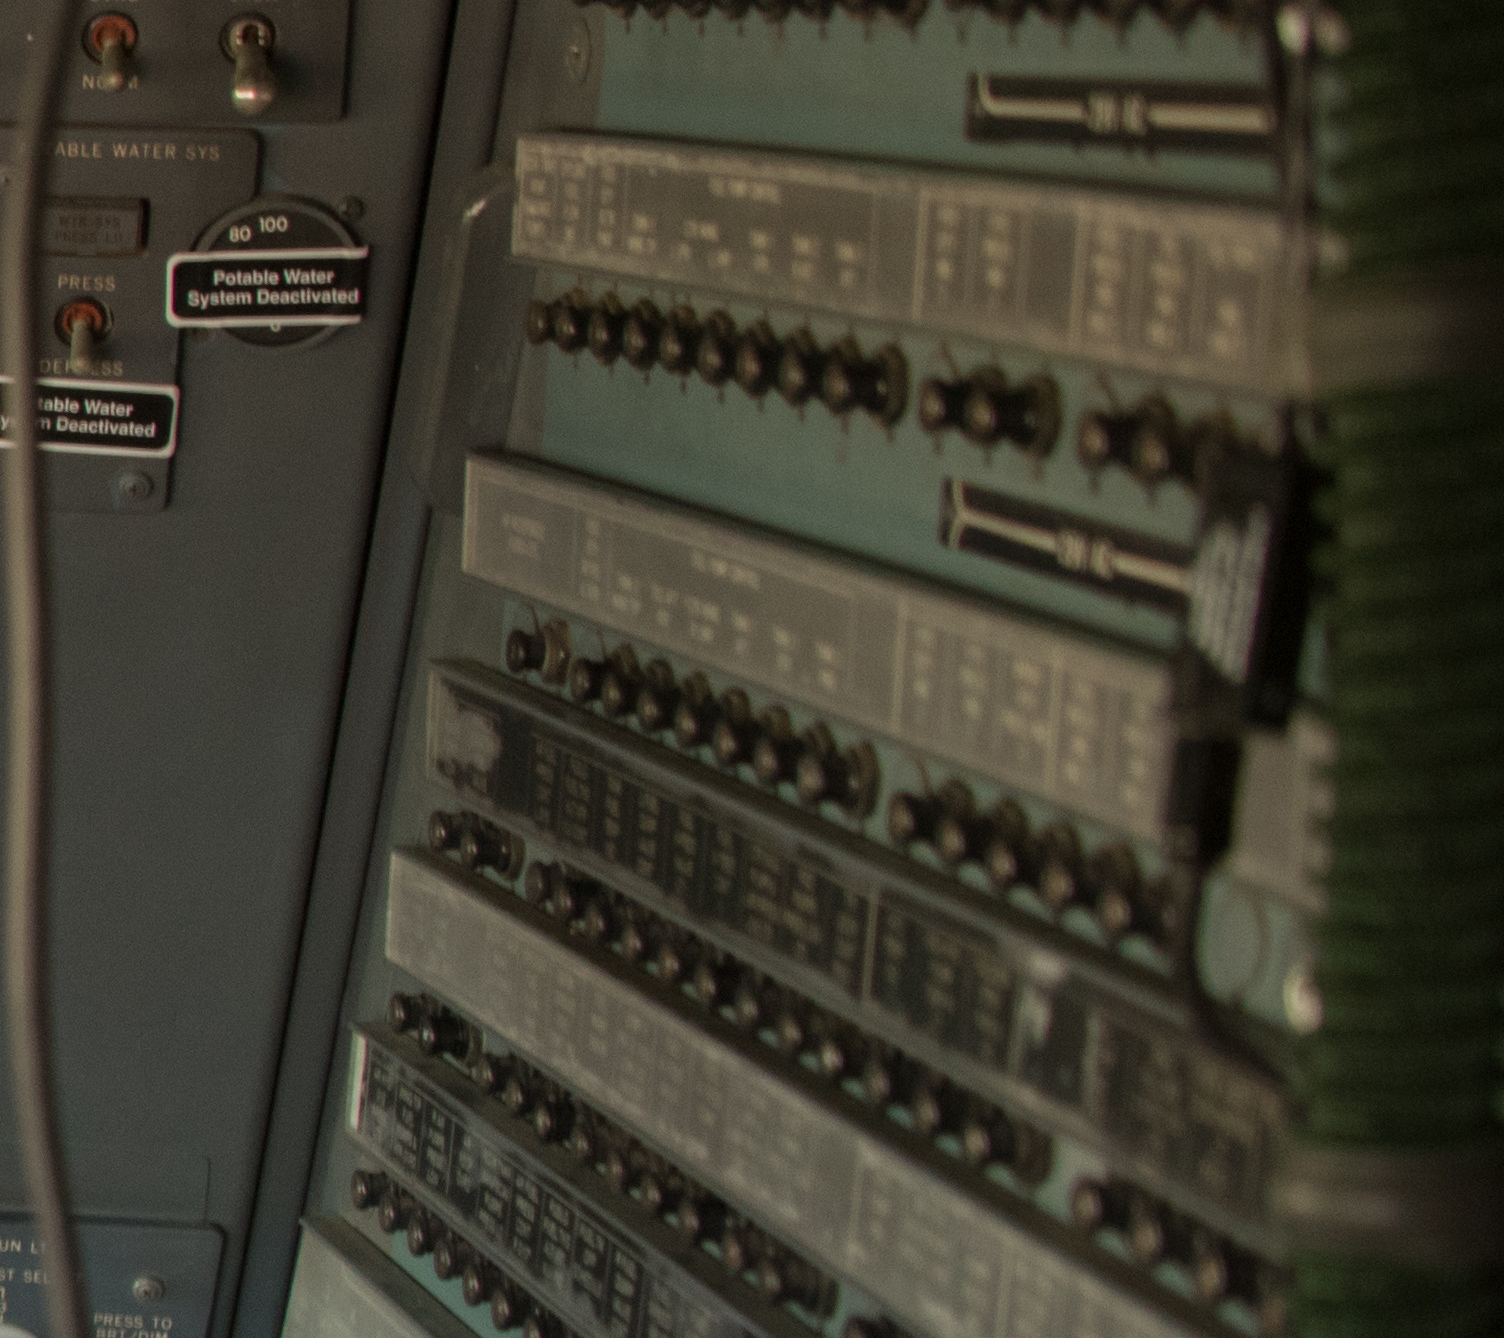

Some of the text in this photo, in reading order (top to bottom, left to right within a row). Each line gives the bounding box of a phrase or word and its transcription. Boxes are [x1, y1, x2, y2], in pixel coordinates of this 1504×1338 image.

[57, 275, 116, 292] PRESS
[213, 268, 334, 286] Potable Water
[187, 287, 359, 308] System Deactivated
[84, 399, 133, 417] Water
[55, 419, 156, 438] Deactivated
